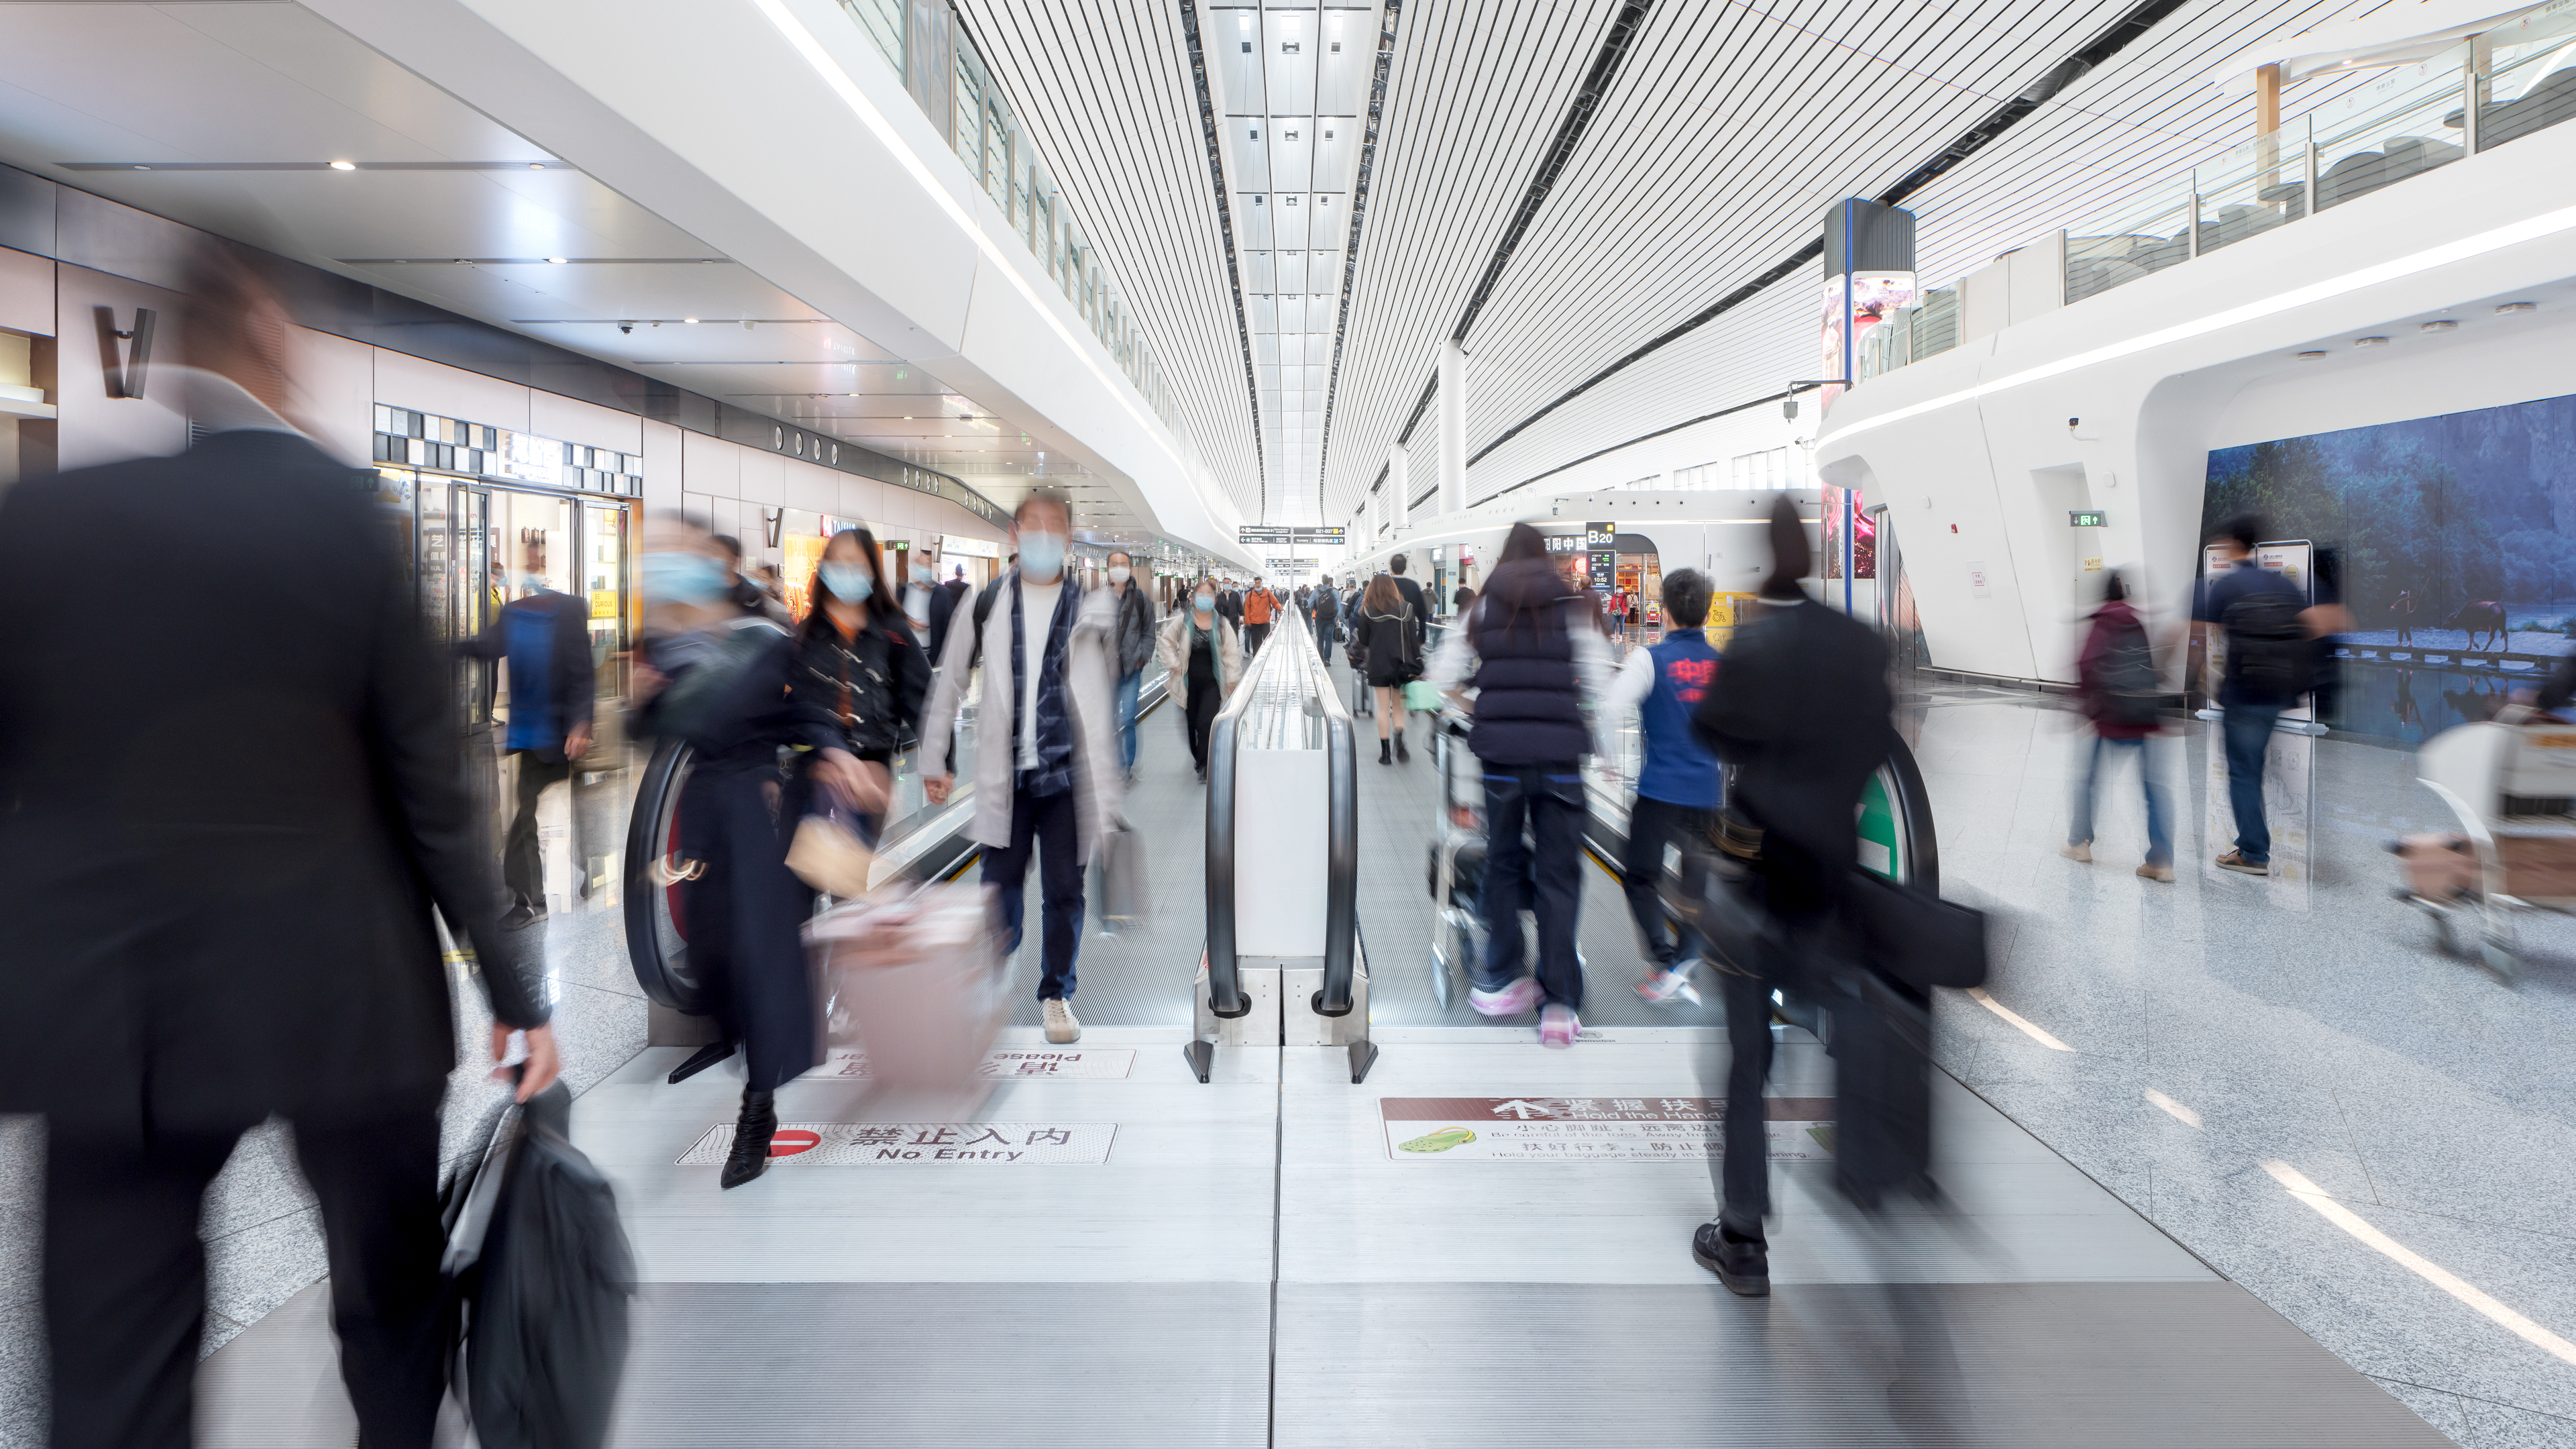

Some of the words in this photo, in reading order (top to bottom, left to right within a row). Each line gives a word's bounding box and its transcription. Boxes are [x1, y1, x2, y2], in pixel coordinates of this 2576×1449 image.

[1588, 530, 1613, 543] B20
[994, 1053, 1082, 1061] Please
[1572, 1112, 1621, 1120] Hold
[1625, 1112, 1659, 1120] the
[850, 1128, 1072, 1146] 禁止入内
[875, 1148, 921, 1159] No
[934, 1148, 1024, 1161] Entry
